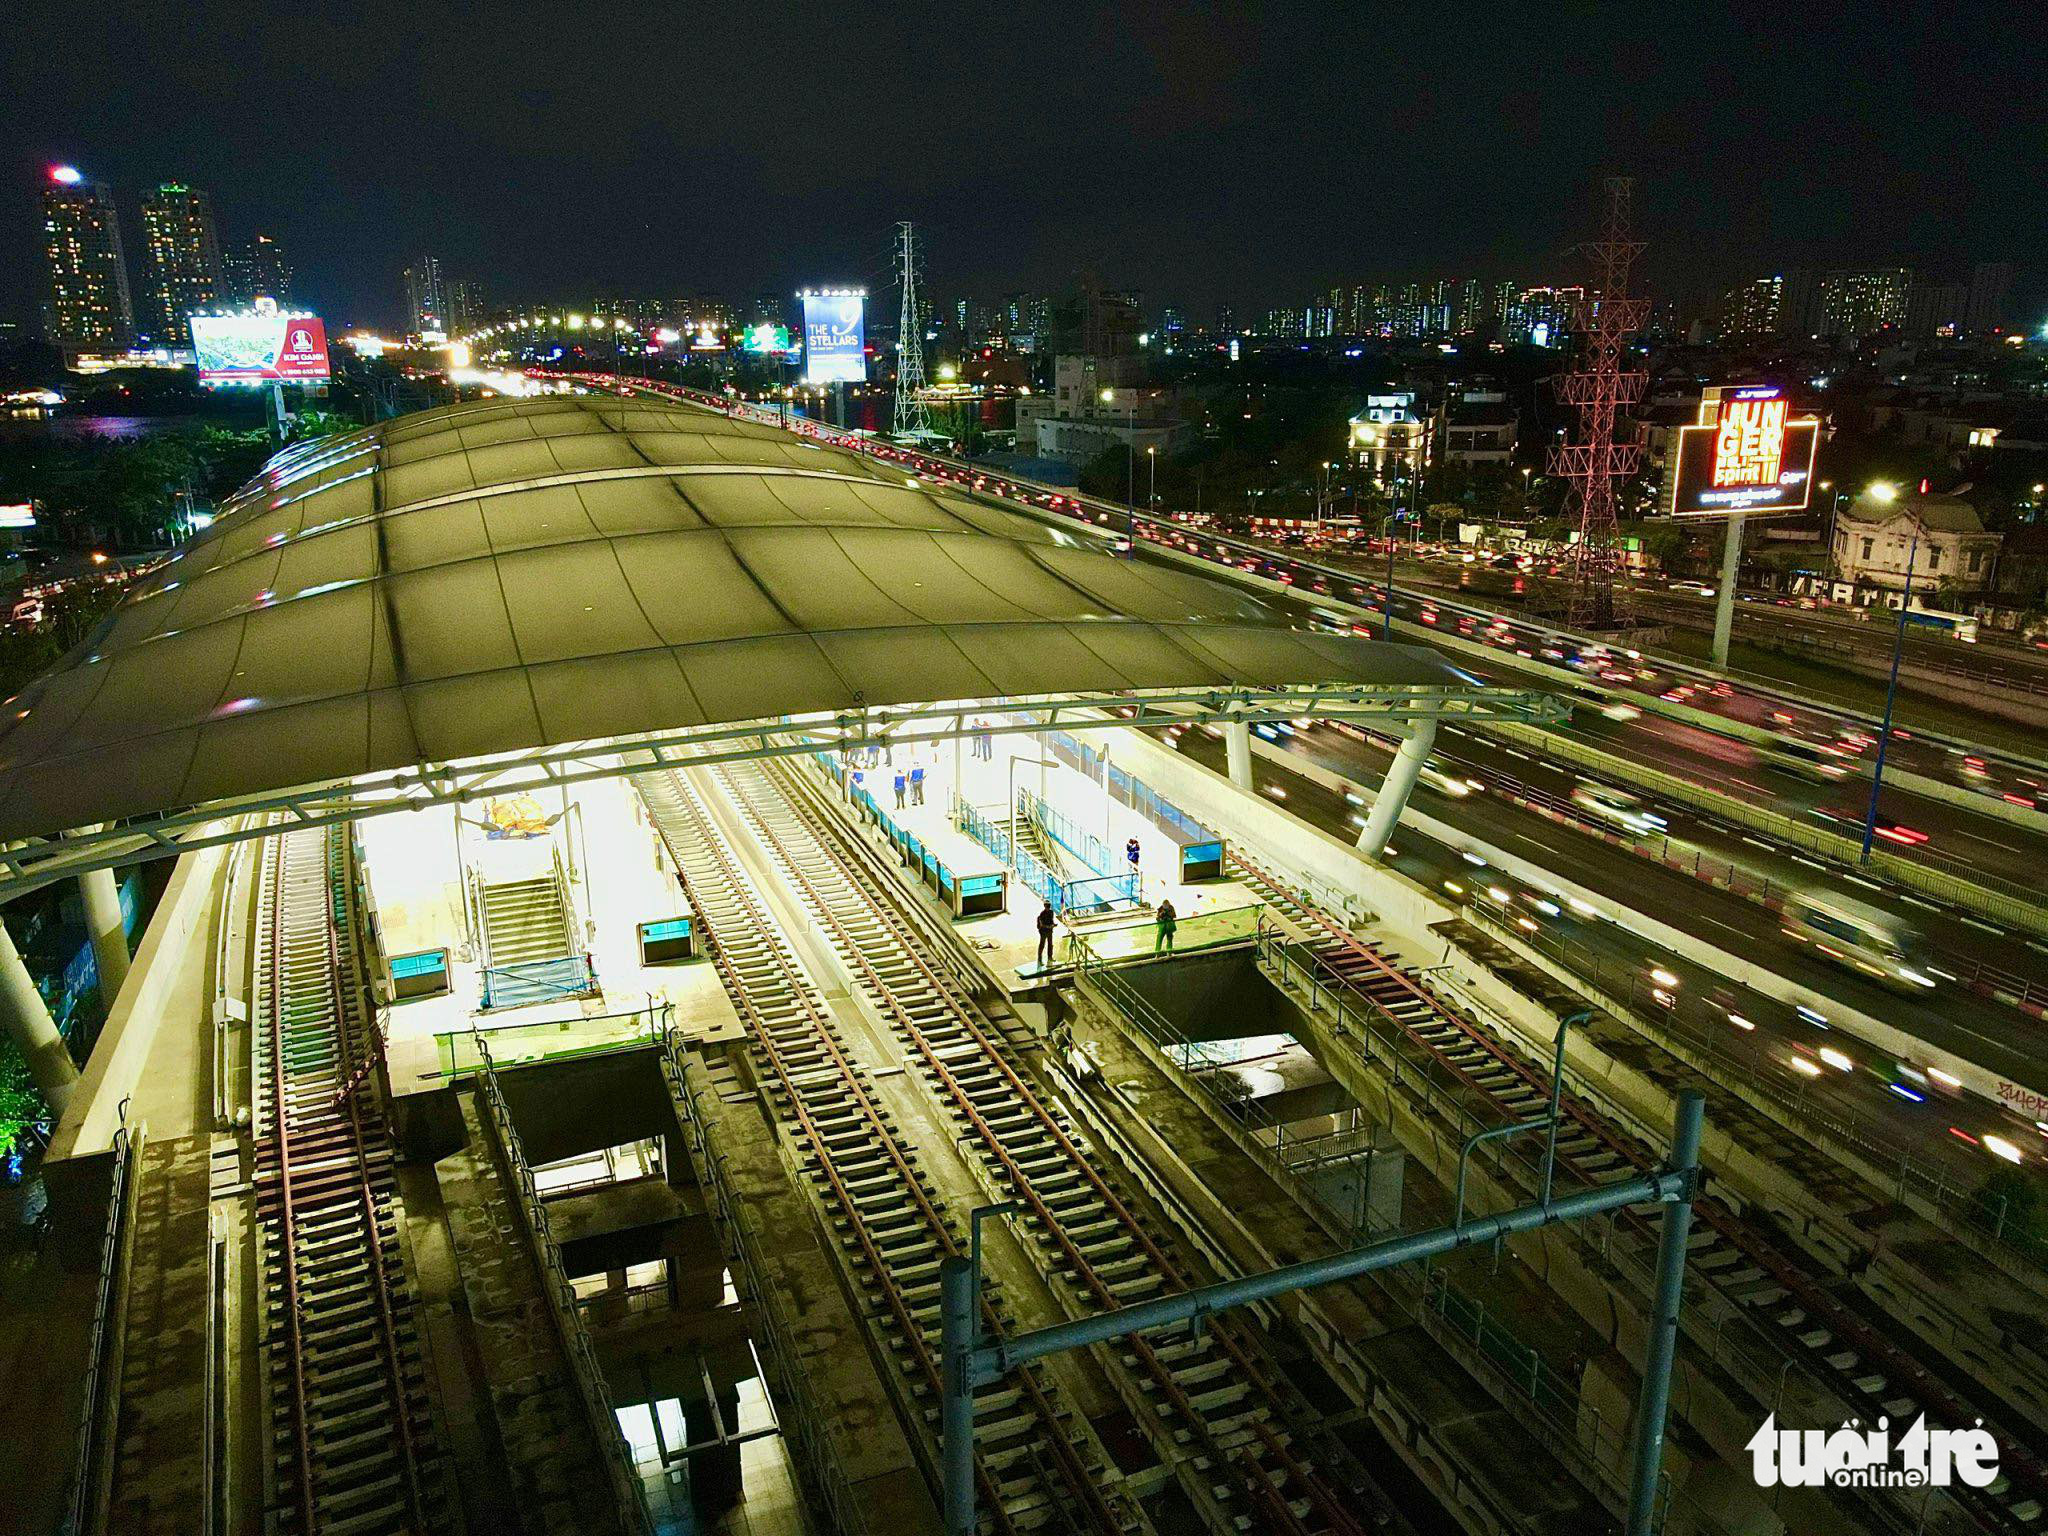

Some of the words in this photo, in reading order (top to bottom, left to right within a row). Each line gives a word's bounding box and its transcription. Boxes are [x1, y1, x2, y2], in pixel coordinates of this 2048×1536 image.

[809, 324, 828, 336] THE
[810, 336, 859, 347] STELLARS
[284, 353, 300, 361] KIM
[301, 353, 325, 361] OANH
